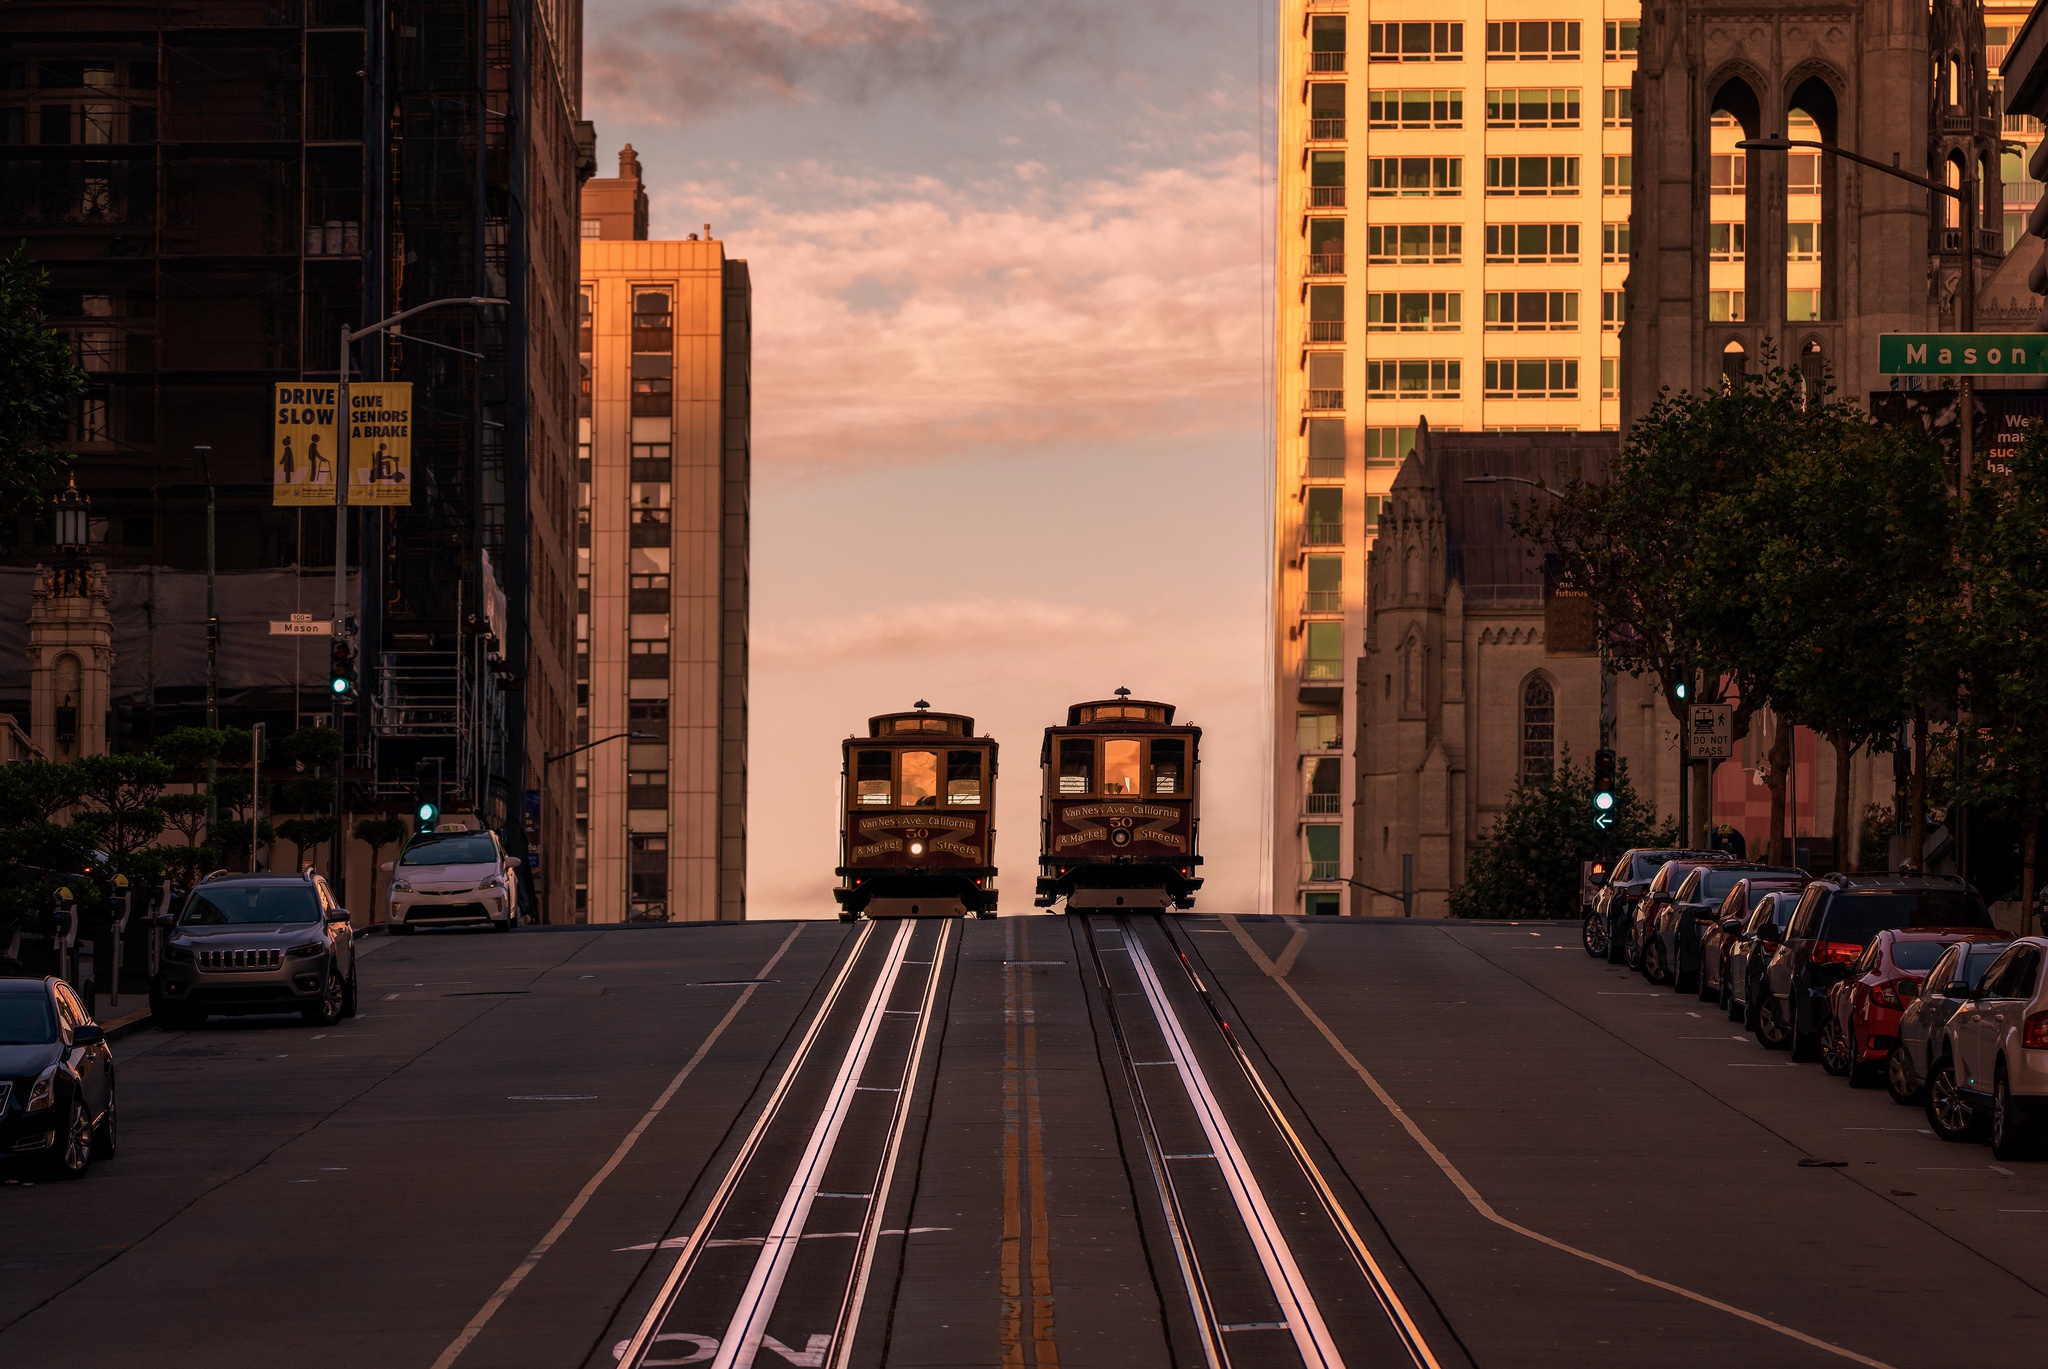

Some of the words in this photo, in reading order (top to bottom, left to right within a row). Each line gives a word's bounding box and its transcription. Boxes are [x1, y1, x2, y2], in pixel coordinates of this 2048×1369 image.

[1906, 343, 2026, 365] Mason
[279, 388, 335, 405] DRIVE
[352, 395, 383, 408] GIVE
[278, 408, 335, 425] SLOW
[352, 410, 408, 423] SENIORS
[352, 426, 361, 438] A
[364, 425, 408, 438] BRAKE
[284, 624, 318, 632] Mason
[1694, 736, 1706, 745] DO
[1711, 735, 1728, 744] NOT
[1699, 747, 1723, 755] PASS
[1065, 808, 1081, 817] Van
[1081, 806, 1104, 815] Ness
[1132, 805, 1179, 818] California
[861, 819, 878, 829] Van
[878, 817, 900, 826] Ness
[928, 816, 975, 829] California
[1109, 817, 1133, 828] 50
[905, 828, 929, 839] 50
[1061, 835, 1068, 844] &
[1070, 829, 1103, 843] Market
[1141, 829, 1180, 844] Streets
[857, 846, 864, 855] &
[866, 840, 899, 853] Market
[937, 840, 976, 855] Streets
